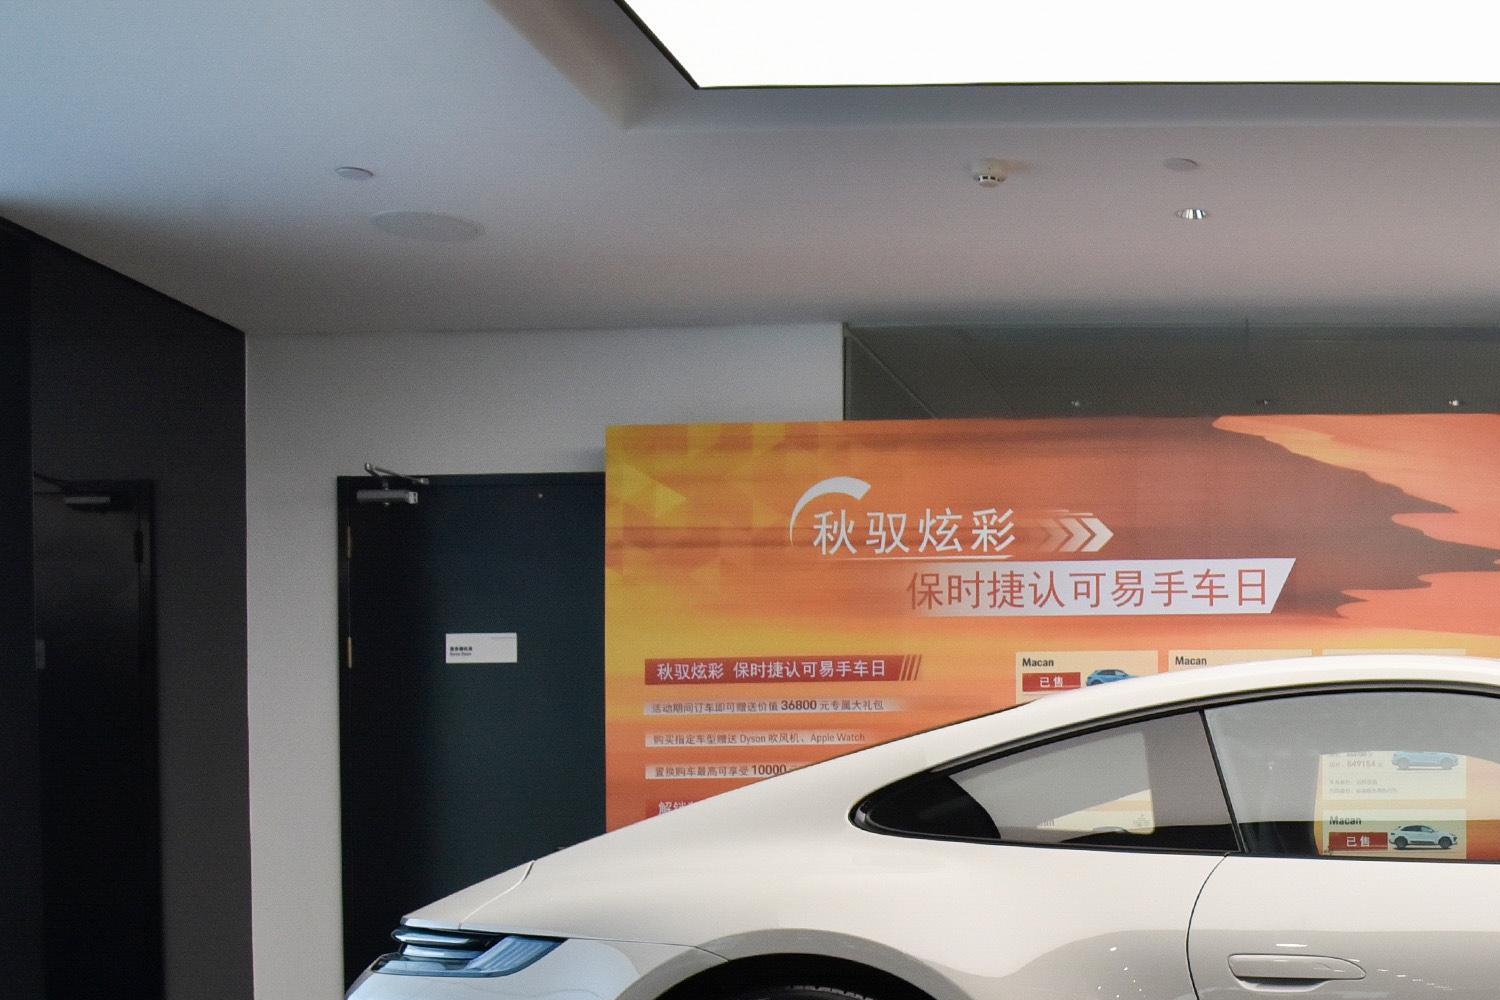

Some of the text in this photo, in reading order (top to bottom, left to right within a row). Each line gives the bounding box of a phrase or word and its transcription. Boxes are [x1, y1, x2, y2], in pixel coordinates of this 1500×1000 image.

[813, 508, 1016, 555] 秋驭炫彩
[906, 567, 1267, 611] 保时捷认可易手车日
[1022, 657, 1055, 668] Macan
[1175, 655, 1207, 666] Macan
[656, 660, 886, 680] 秋驭炫彩 保时捷认可易手车日
[780, 700, 817, 711] 36800
[740, 734, 766, 744] Dyson
[836, 732, 865, 742] Watch
[752, 764, 787, 775] 10000
[1329, 816, 1362, 826] Macan
